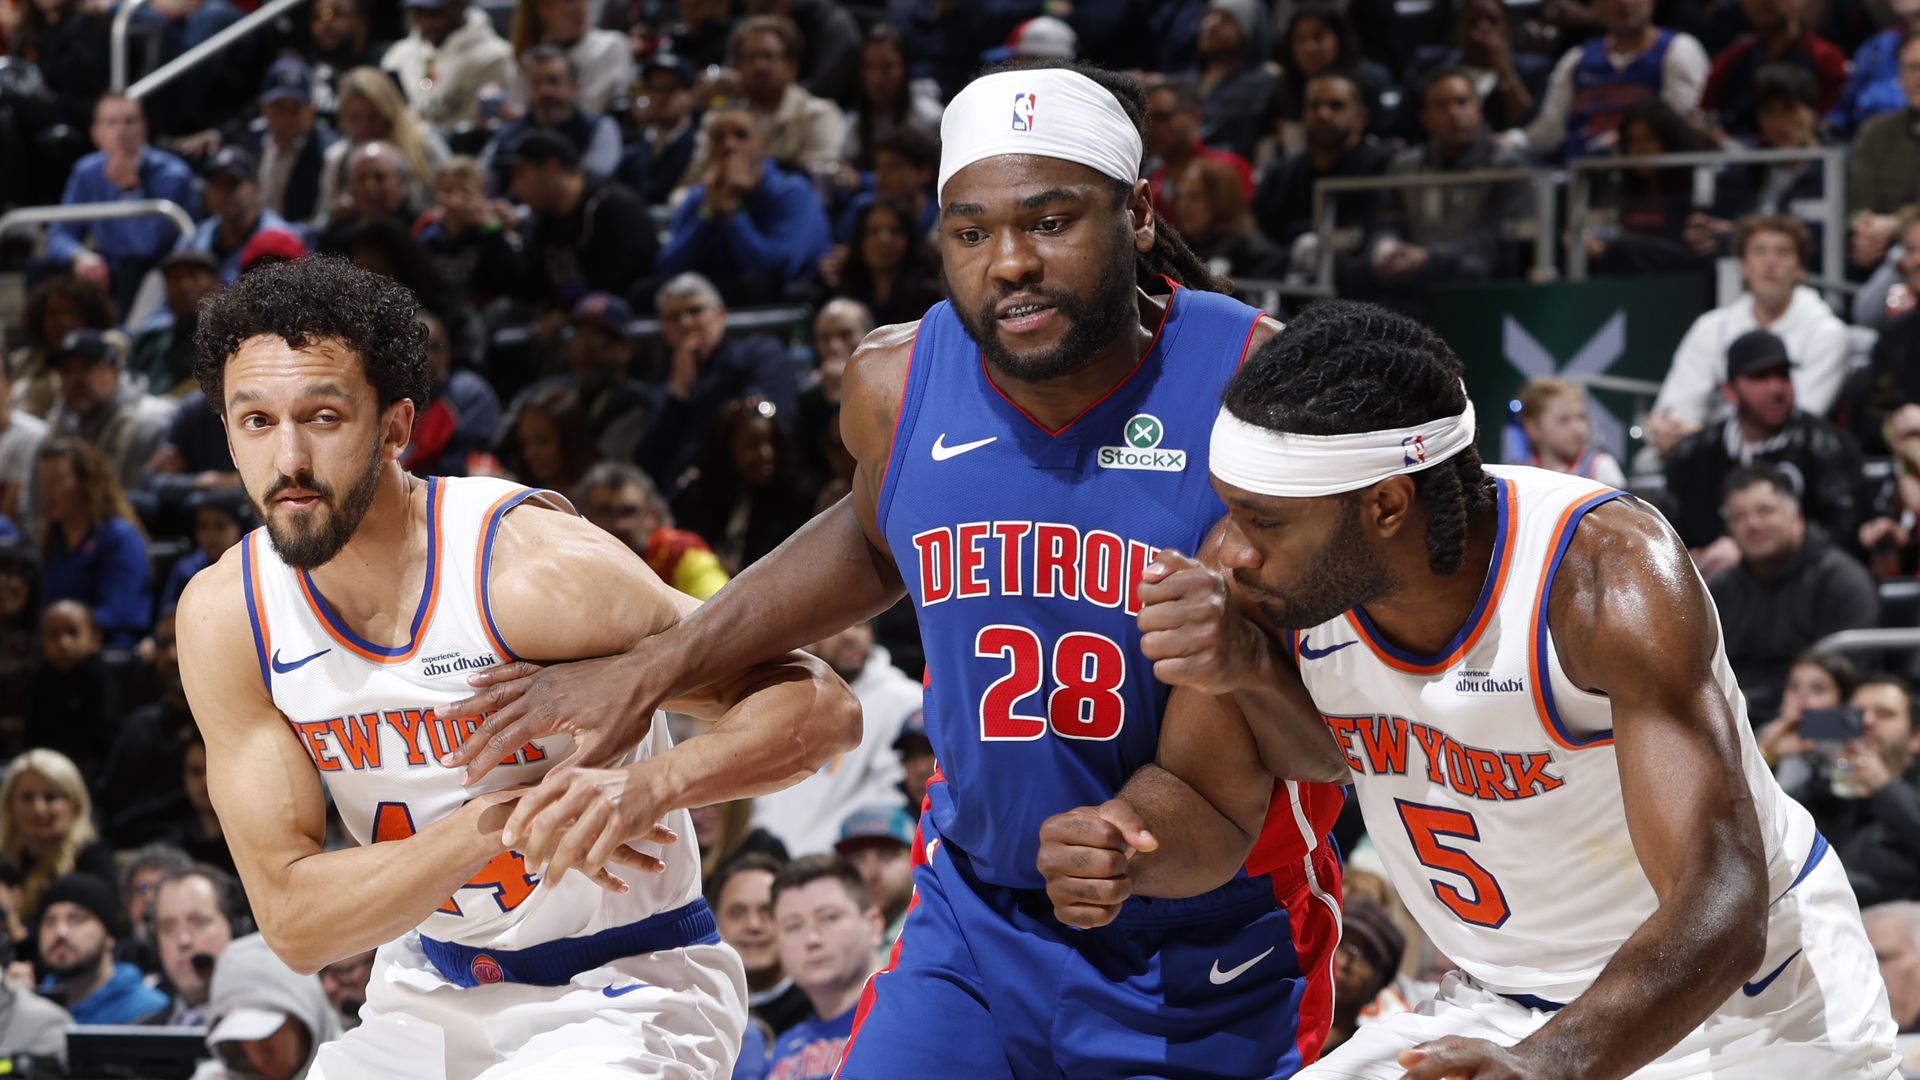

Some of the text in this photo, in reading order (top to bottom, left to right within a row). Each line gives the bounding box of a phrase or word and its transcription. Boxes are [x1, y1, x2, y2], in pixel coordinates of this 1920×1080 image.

[1100, 448, 1183, 468] StockX
[912, 520, 1163, 617] DETROI
[421, 651, 461, 664] experience
[423, 653, 496, 677] abu dhabi
[974, 623, 1126, 742] 28
[1455, 677, 1524, 693] abu dhabi
[292, 709, 385, 772] EW
[1320, 713, 1567, 802] EW YORK
[1393, 797, 1512, 929] 5
